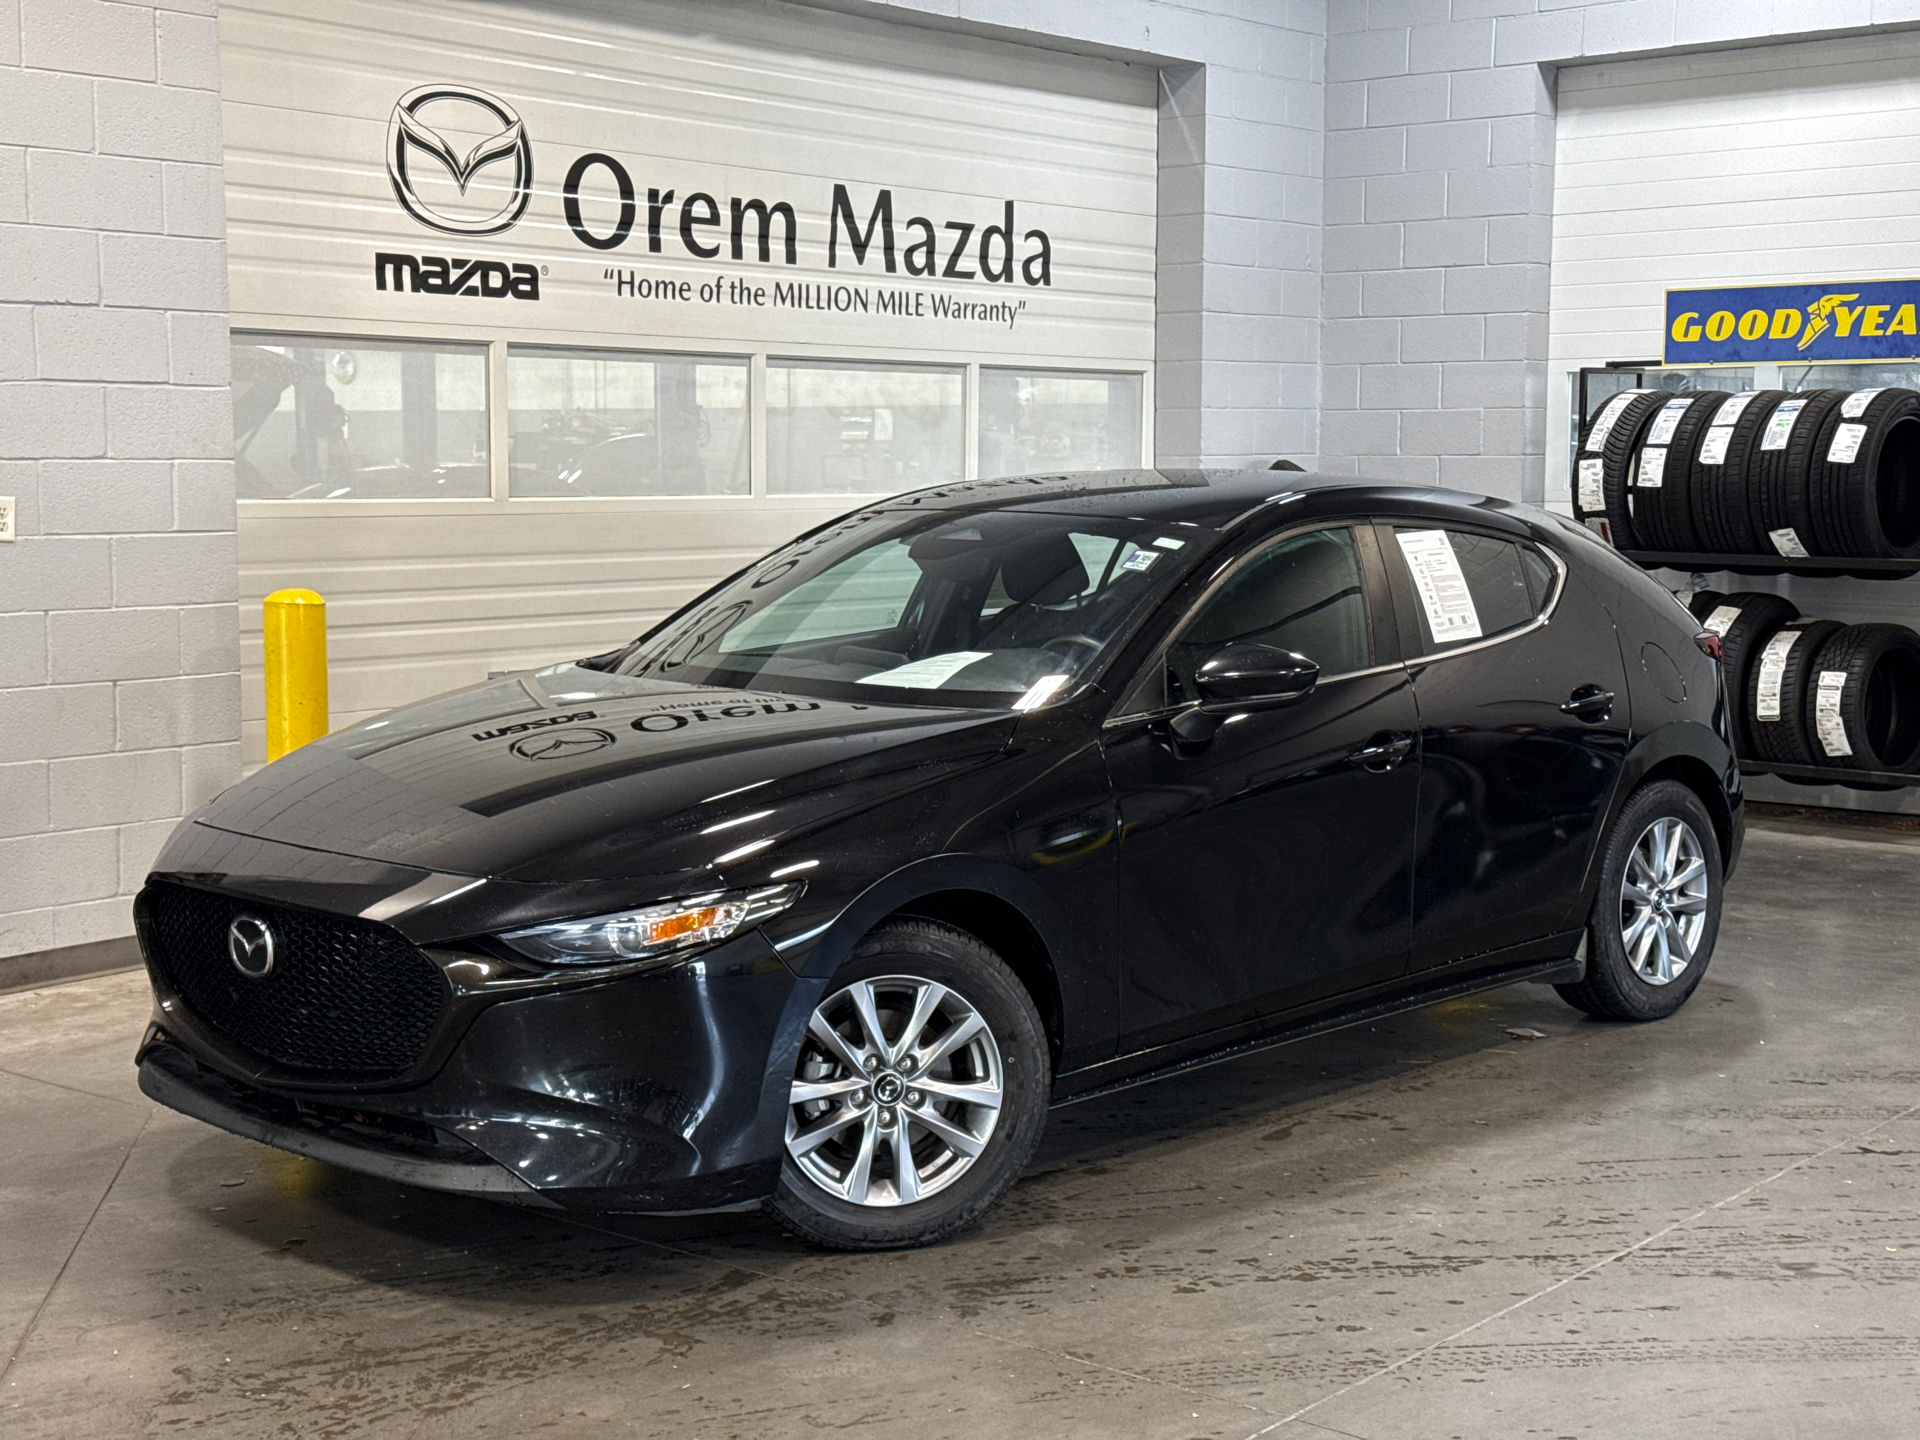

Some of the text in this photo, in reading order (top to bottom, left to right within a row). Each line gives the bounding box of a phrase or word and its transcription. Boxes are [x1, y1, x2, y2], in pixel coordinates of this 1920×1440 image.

[563, 152, 1053, 287] Orem Mazda
[699, 275, 725, 304] of
[729, 277, 766, 307] the
[773, 281, 869, 314] MILLION
[876, 289, 925, 318] MILE
